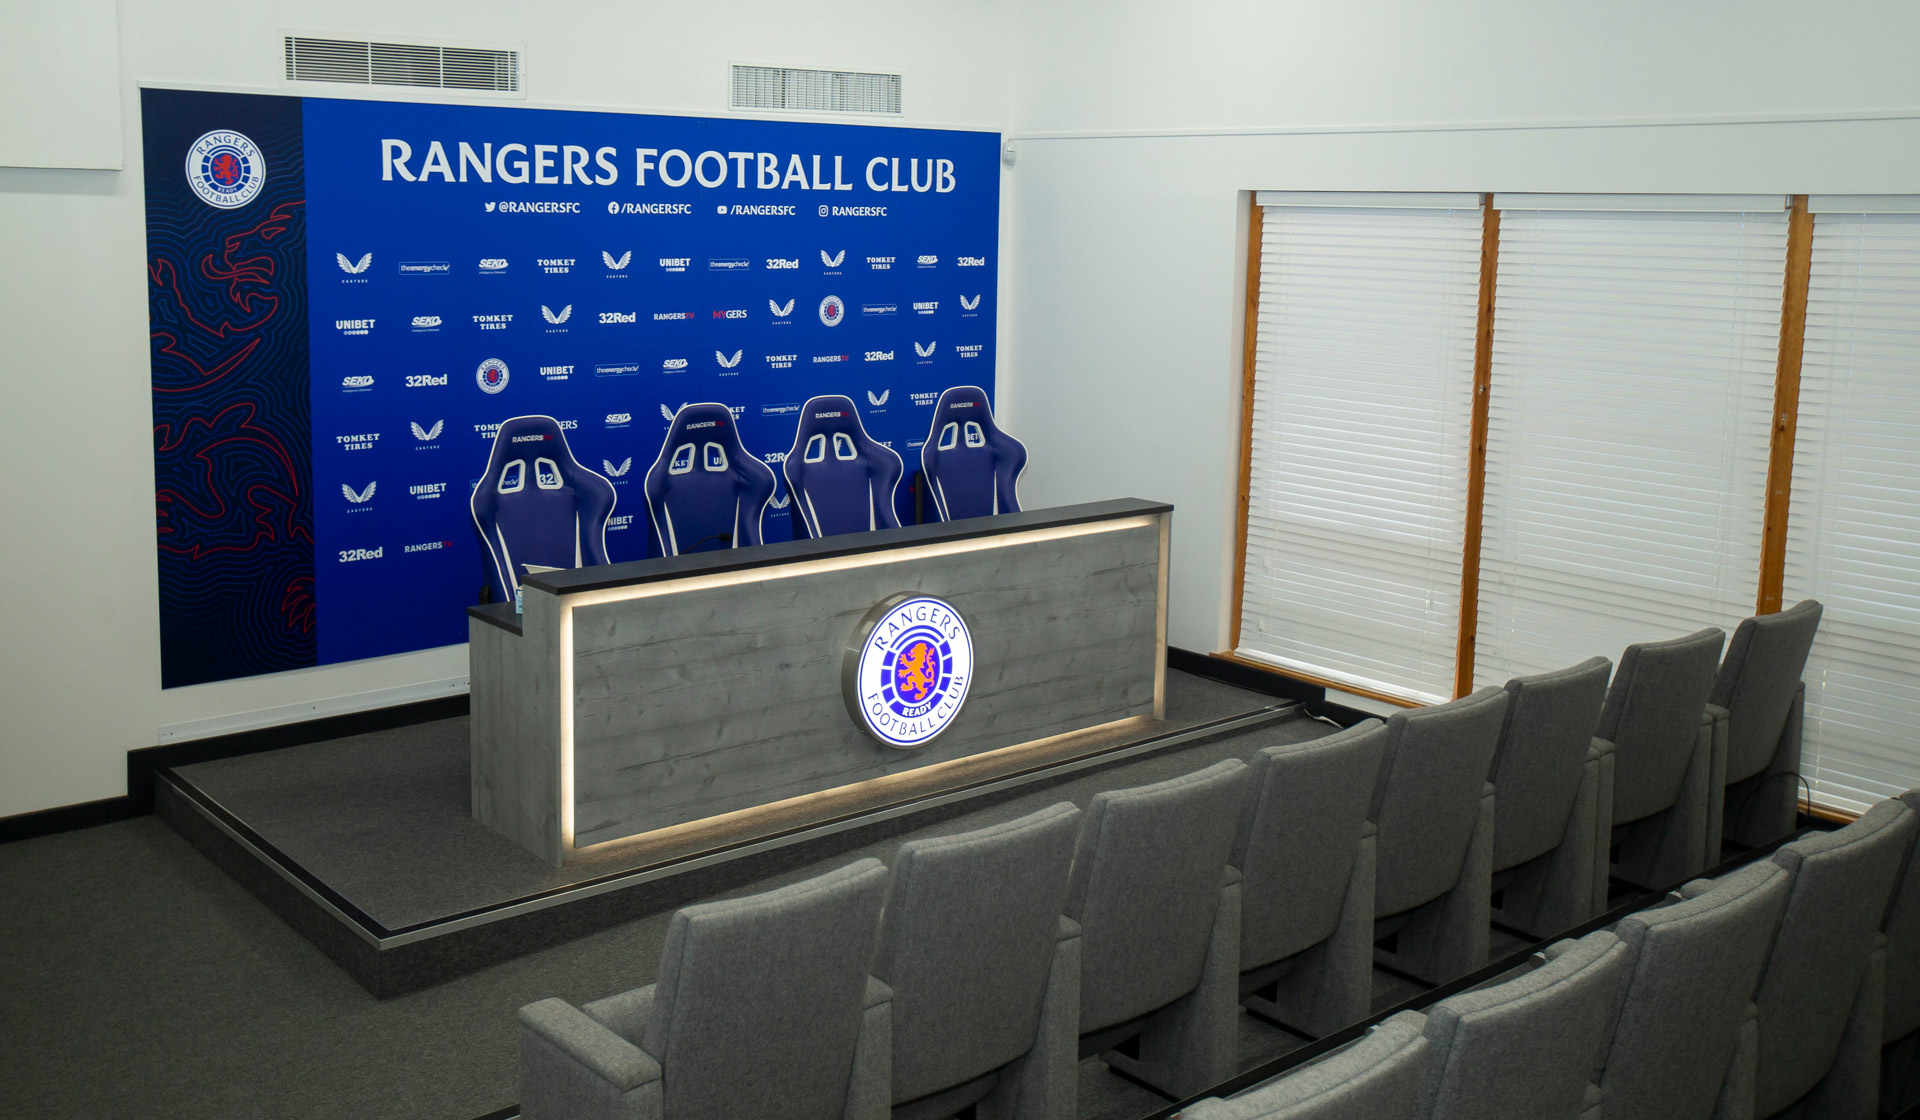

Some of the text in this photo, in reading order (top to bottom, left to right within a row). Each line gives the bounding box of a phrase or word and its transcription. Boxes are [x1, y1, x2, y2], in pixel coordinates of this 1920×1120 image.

[196, 135, 255, 157] RANGERS
[381, 138, 956, 193] RANGERS FOOTBALL CLUB
[194, 175, 259, 204] FOOTBALL CLUB
[499, 201, 580, 214] @RANGERSFC
[621, 203, 691, 215] /RANGERSFC
[730, 204, 796, 216] /RANGERSFC
[832, 206, 887, 217] RANGERSFC
[479, 259, 509, 269] SEKO
[537, 259, 576, 267] TOMKET
[660, 258, 691, 267] UNIBET
[766, 258, 799, 270] 32Red
[957, 256, 985, 267] 32Red
[913, 301, 939, 311] UNIBET
[473, 315, 514, 323] TOMKET
[599, 312, 636, 324] 32Red
[654, 312, 695, 321] RANGERSTV
[713, 309, 747, 320] MYGERS
[336, 319, 376, 330] UNIBET
[411, 316, 442, 327] SEKO
[813, 354, 849, 363] RANGERSTV
[864, 350, 894, 361] 32Red
[663, 359, 688, 369] SEKO
[540, 365, 574, 376] UNIBET
[342, 375, 375, 387] SEKO
[405, 373, 448, 388] 32Red
[910, 392, 939, 400] TOMKET
[605, 413, 632, 424] SEKO
[474, 424, 501, 432] TOMK
[336, 433, 380, 444] TOMKET
[344, 442, 373, 451] TIRES
[764, 452, 786, 463] 32R
[410, 483, 447, 495] UNIBET
[608, 515, 634, 526] NIBET
[404, 540, 453, 553] RANGERSTV
[339, 546, 383, 563] 32Red
[874, 606, 960, 651] RANGERS
[868, 676, 964, 736] FOOTBALL CLUB
[902, 701, 932, 717] READY
